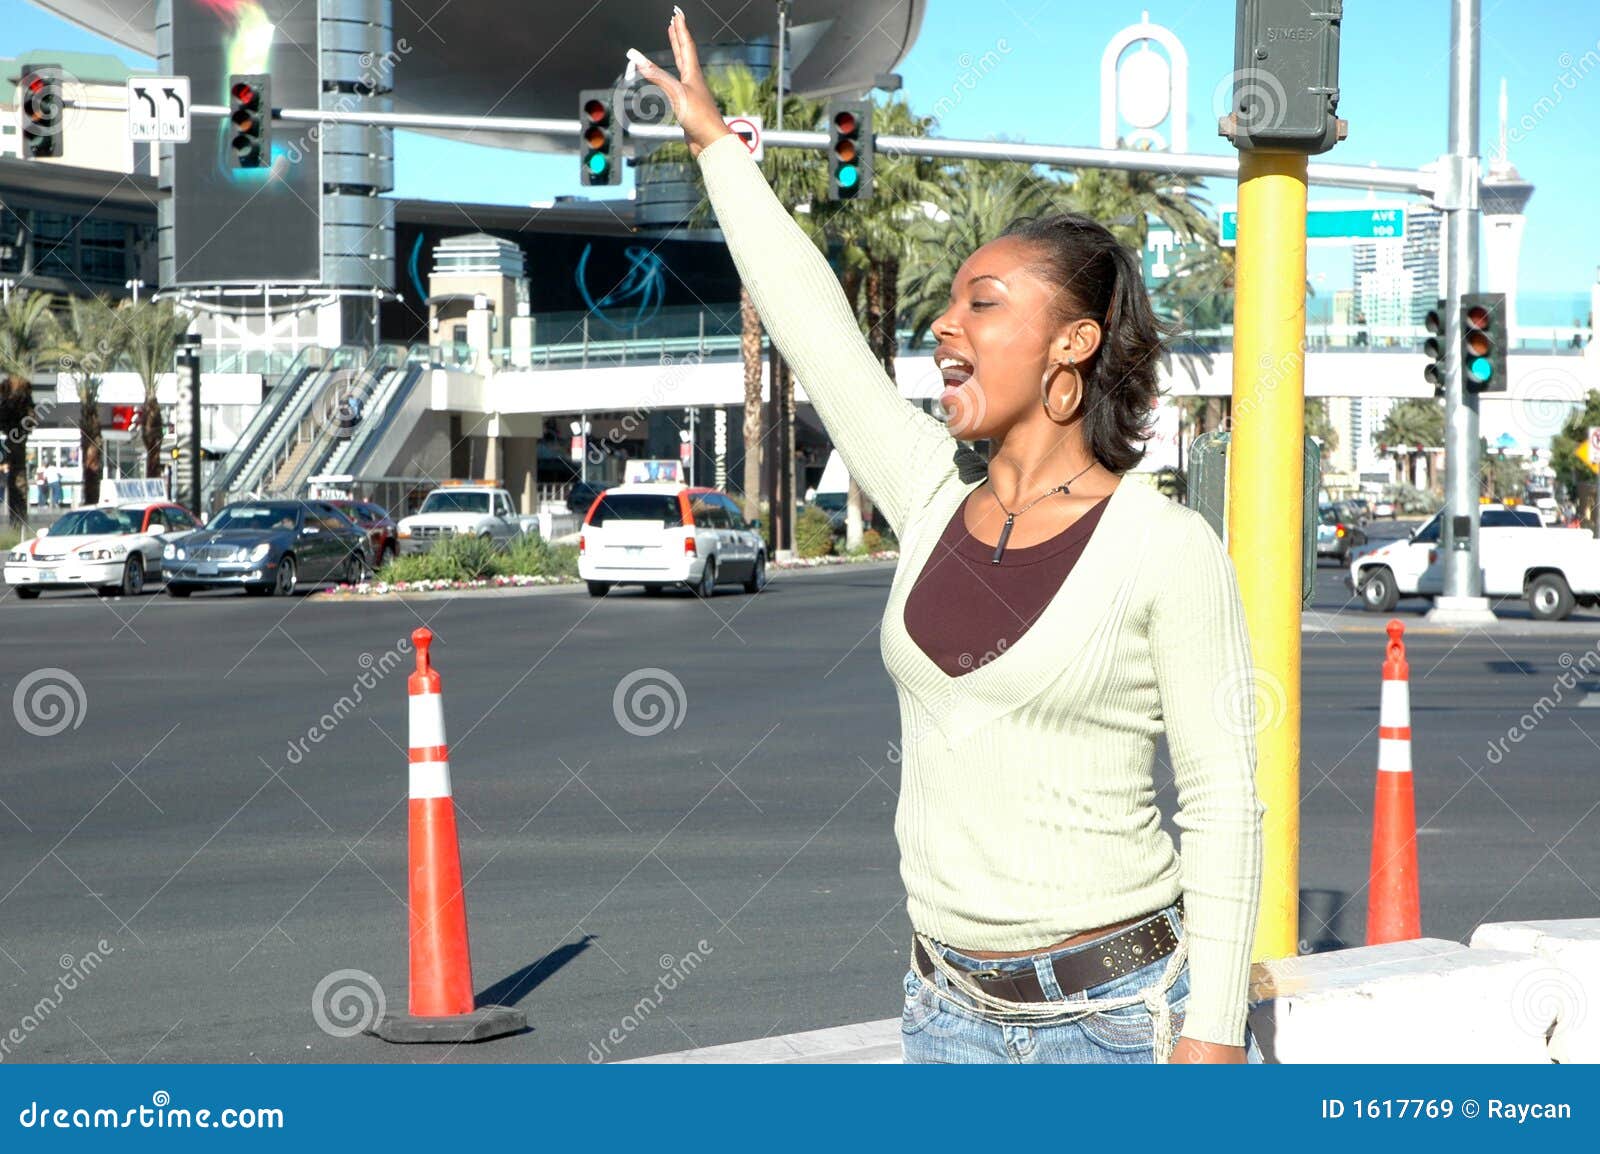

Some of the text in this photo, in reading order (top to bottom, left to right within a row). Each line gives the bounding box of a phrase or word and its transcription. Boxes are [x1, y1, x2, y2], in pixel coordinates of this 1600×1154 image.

[132, 122, 156, 136] ONLY
[162, 122, 186, 137] ONLY
[1371, 210, 1396, 222] AVE
